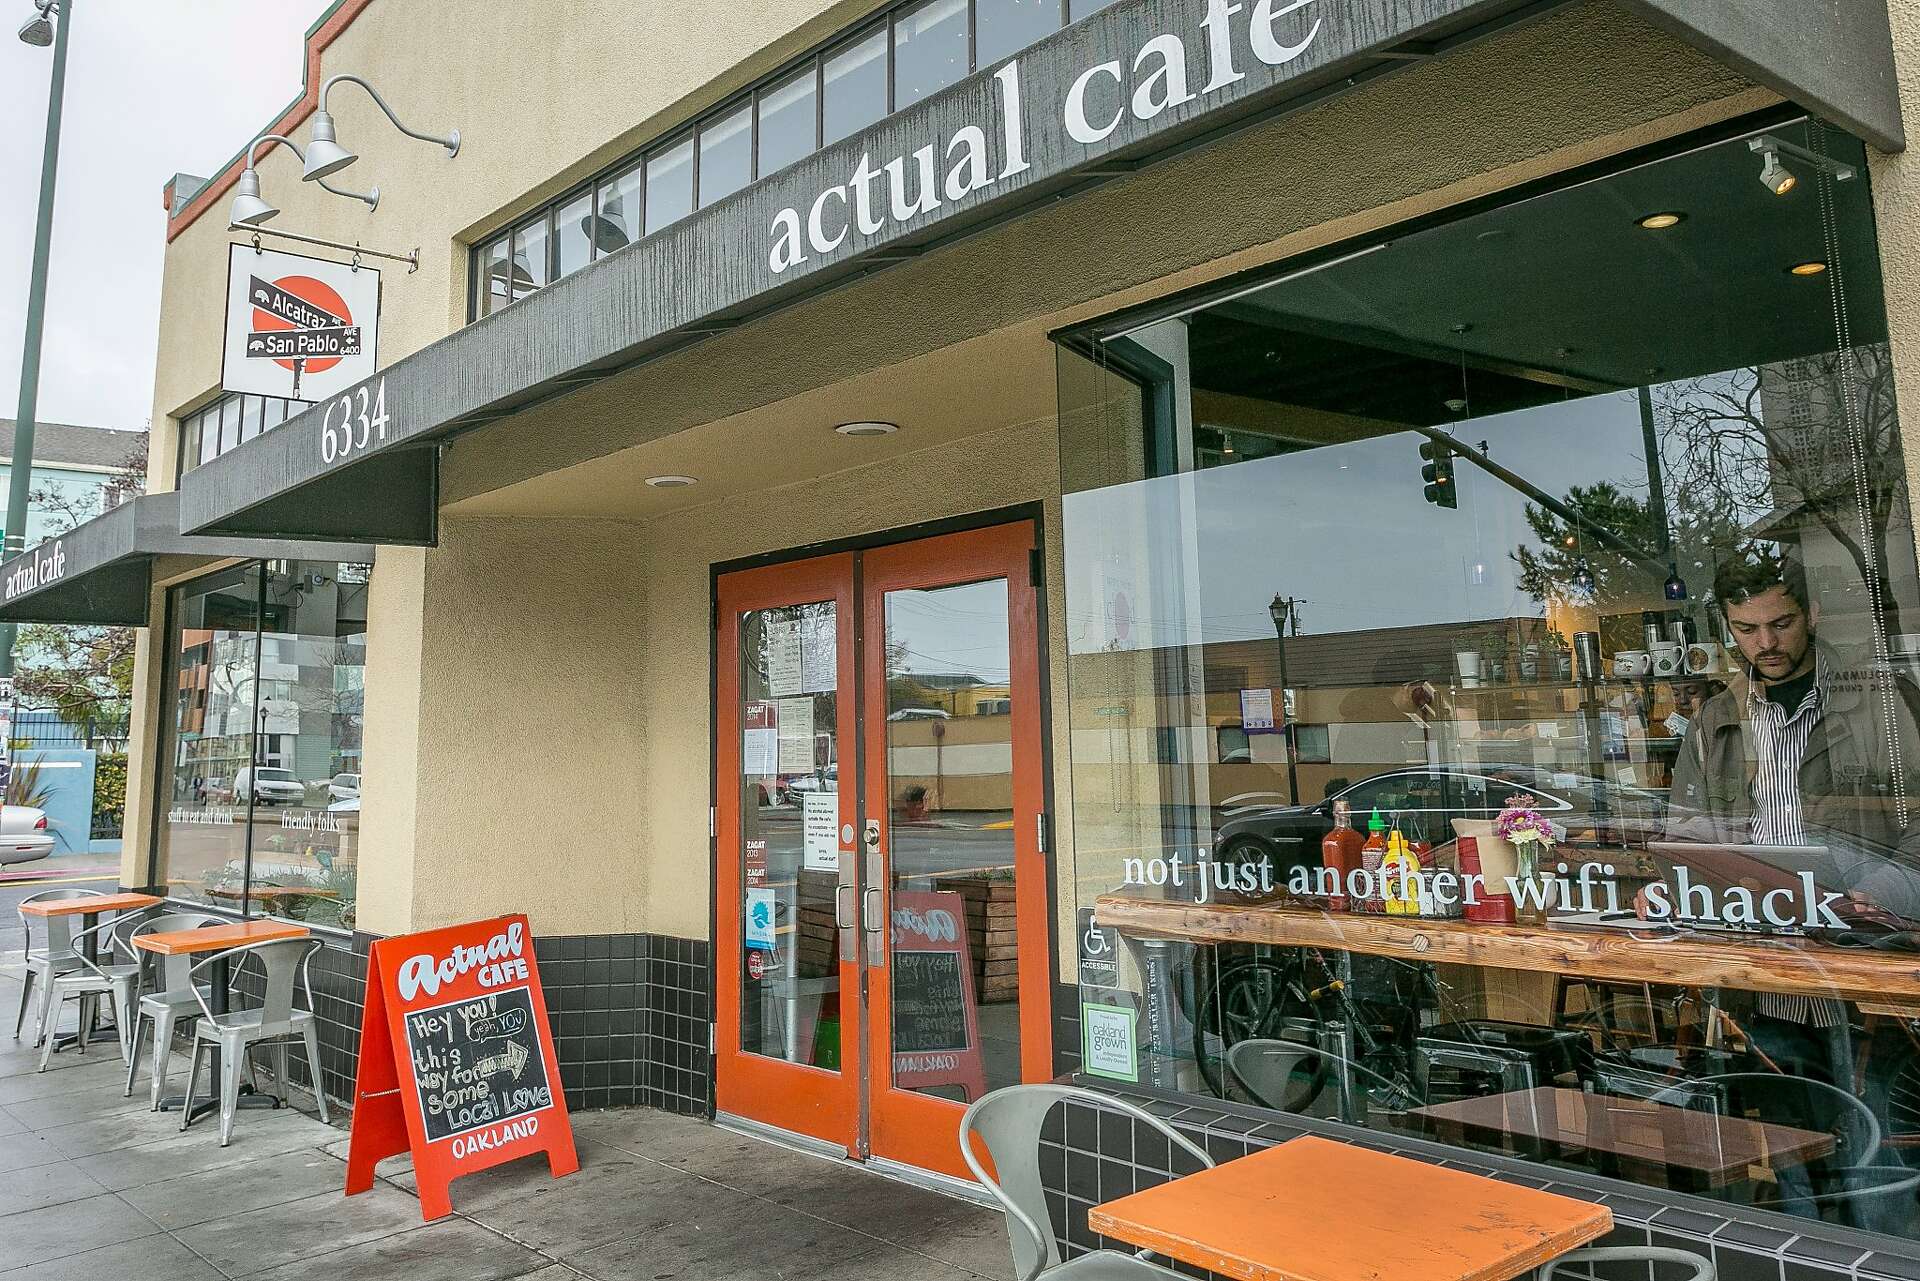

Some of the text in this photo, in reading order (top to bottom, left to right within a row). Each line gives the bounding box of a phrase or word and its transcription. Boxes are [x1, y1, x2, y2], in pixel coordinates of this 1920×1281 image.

[769, 59, 1030, 273] actual
[272, 293, 327, 328] Alcatraz
[266, 335, 338, 354] San Pablo
[343, 327, 357, 336] AVE
[340, 345, 360, 355] 6400
[321, 376, 389, 463] 6334
[5, 540, 66, 599] actual cafe
[746, 705, 765, 714] ZAGAT
[189, 809, 199, 824] eat
[214, 806, 233, 825] drink
[281, 810, 340, 837] friendly folks
[746, 840, 766, 849] ZAGAT
[746, 867, 766, 877] ZAGAT
[1122, 849, 1184, 887] not
[1194, 848, 1274, 904] just
[1288, 855, 1484, 906] another
[1504, 861, 1620, 915] wifi
[1644, 866, 1851, 930] shack
[477, 957, 529, 988] CAFE
[1081, 961, 1116, 972] ACCESSIBLE
[411, 1012, 454, 1044] Hey
[1093, 1022, 1126, 1040] oakland
[1094, 1035, 1127, 1051] grown
[415, 1045, 461, 1073] this
[416, 1065, 481, 1092] way for
[451, 1116, 538, 1160] OAKLAND
